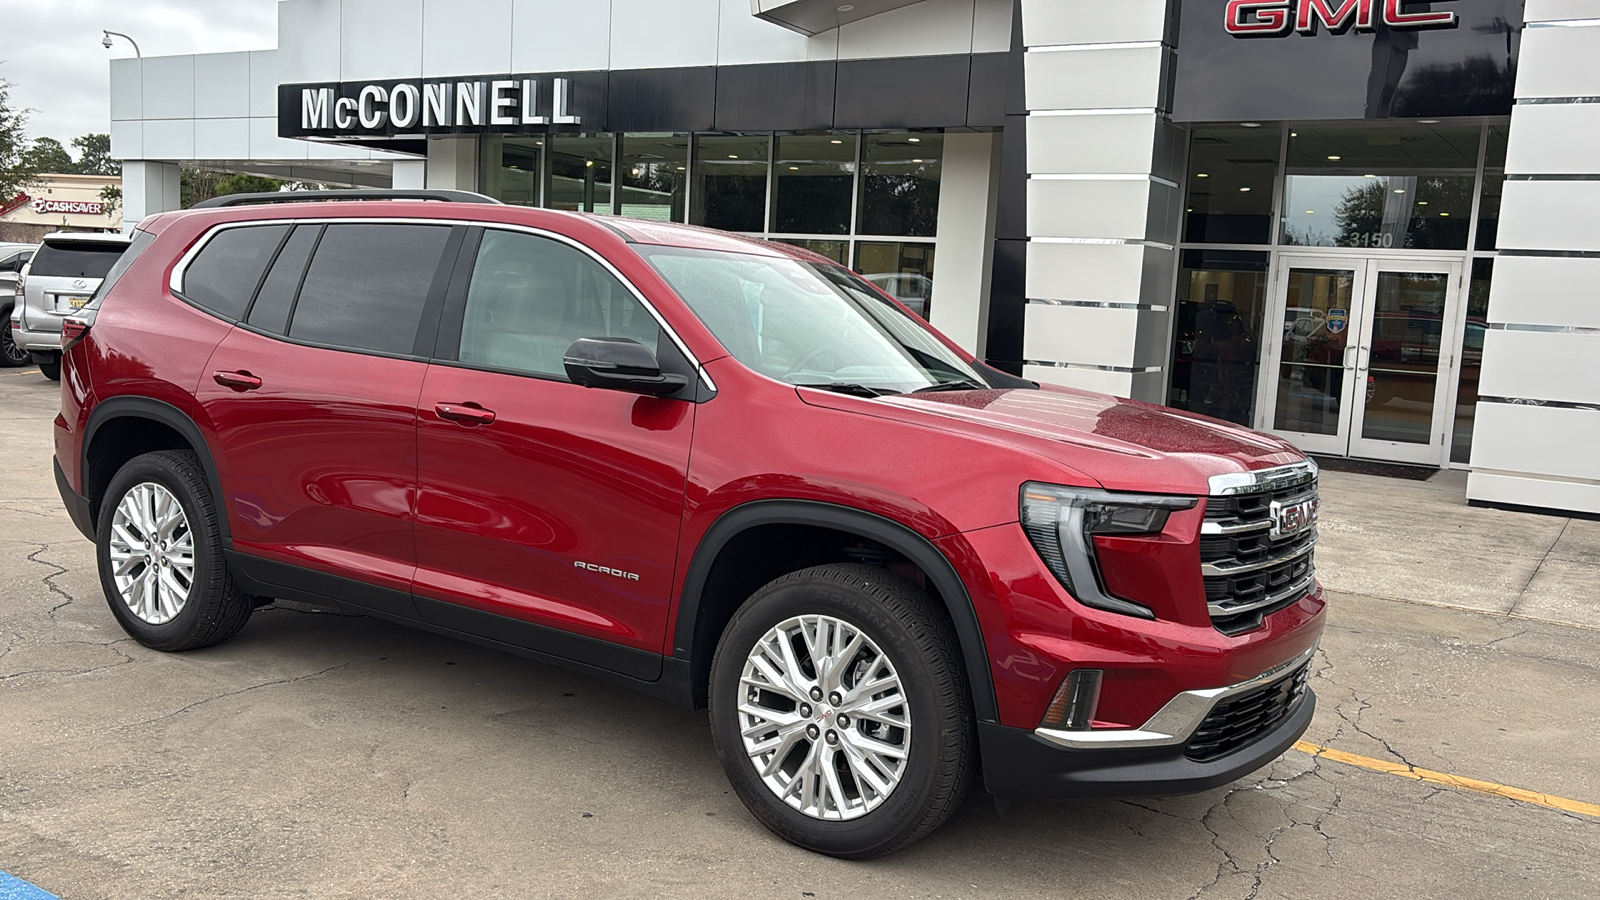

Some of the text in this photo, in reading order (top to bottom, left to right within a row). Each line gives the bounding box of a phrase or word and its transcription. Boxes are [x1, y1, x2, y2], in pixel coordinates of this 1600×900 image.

[1224, 0, 1457, 35] GMC
[301, 78, 581, 129] McCONNELL
[46, 200, 101, 213] CASHSAVER
[1350, 232, 1393, 248] 3150
[574, 561, 640, 581] ACADIA
